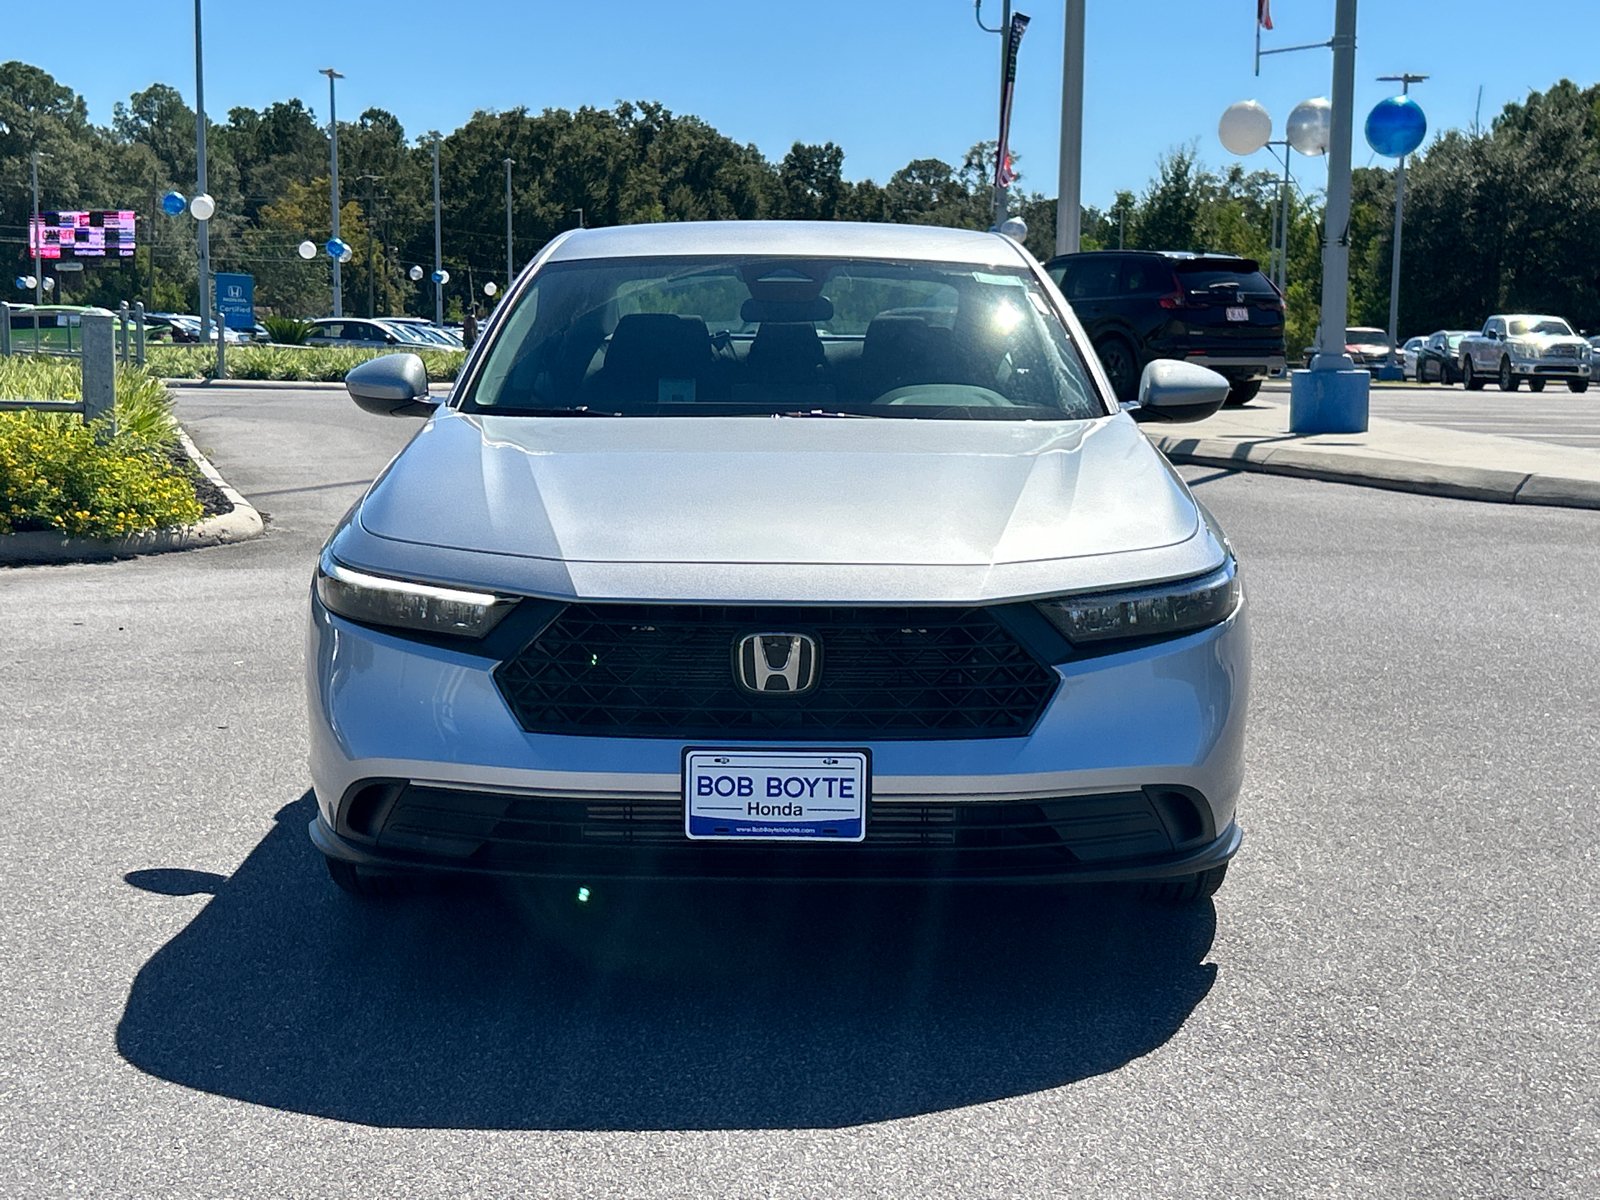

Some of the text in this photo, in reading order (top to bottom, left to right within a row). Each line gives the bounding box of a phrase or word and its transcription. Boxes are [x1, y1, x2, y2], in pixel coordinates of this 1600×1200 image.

[219, 304, 251, 313] Certified
[697, 775, 855, 799] BOB BOYTE
[747, 802, 803, 817] Honda
